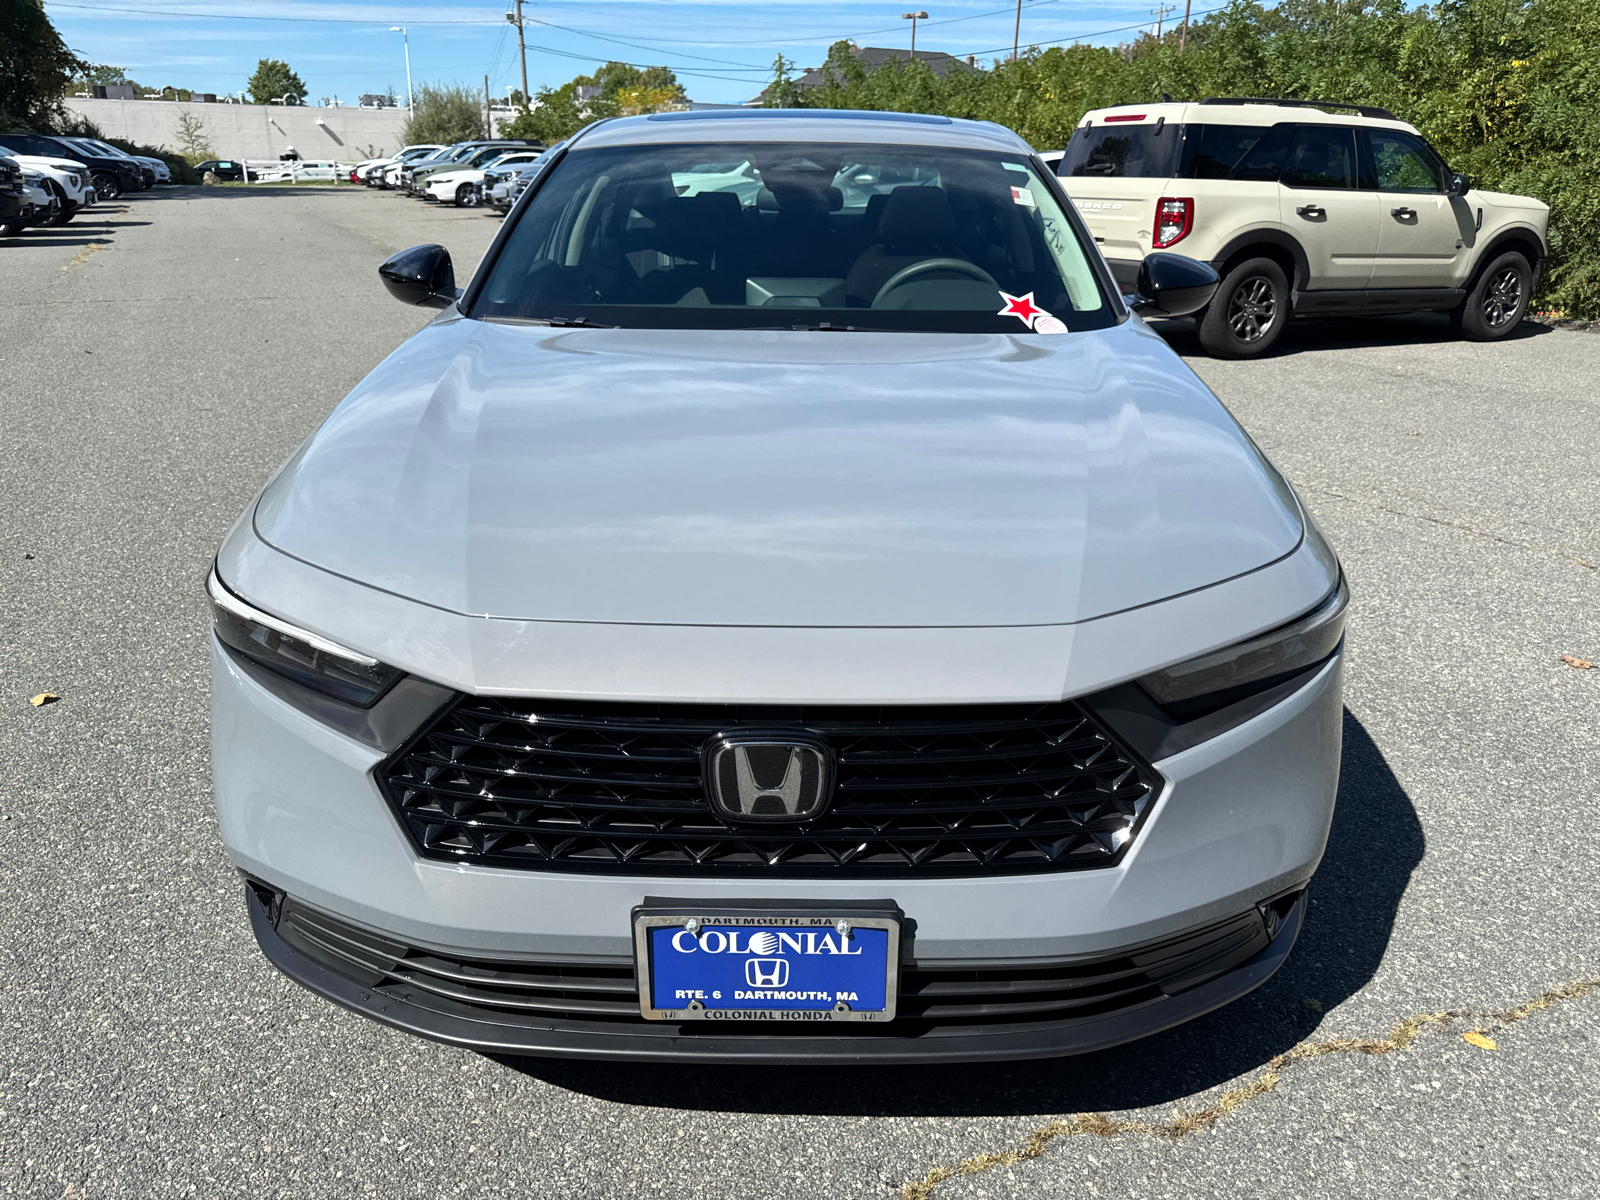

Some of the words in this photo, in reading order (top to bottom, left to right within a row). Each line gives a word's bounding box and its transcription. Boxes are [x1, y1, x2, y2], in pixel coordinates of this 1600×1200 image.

[1075, 202, 1122, 210] RONCO
[701, 917, 805, 926] DARTMOUTH,
[809, 918, 833, 926] MA
[671, 930, 863, 956] COLONIAL
[675, 989, 709, 999] RTE.
[712, 990, 722, 1000] 6
[734, 990, 832, 1002] DARTMOUTH,
[836, 991, 859, 1001] MA
[704, 1010, 776, 1020] COLONIAL
[780, 1011, 833, 1020] HONDA
